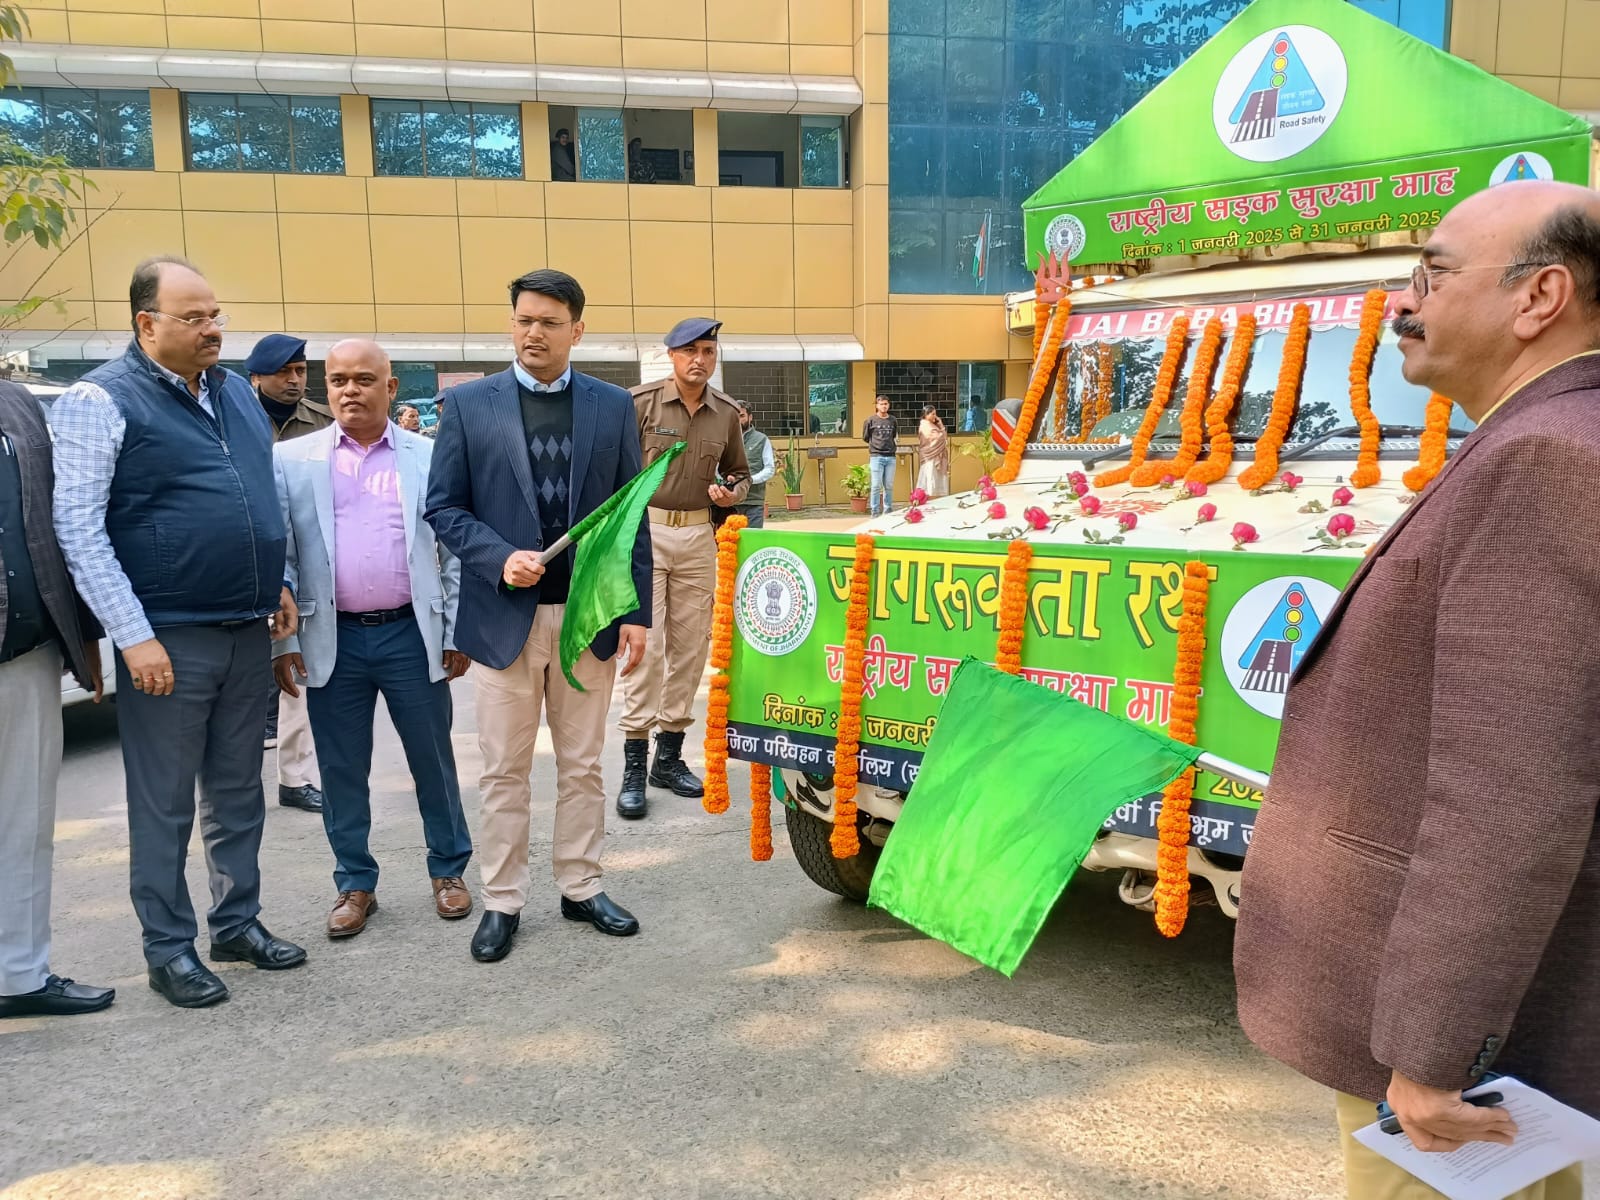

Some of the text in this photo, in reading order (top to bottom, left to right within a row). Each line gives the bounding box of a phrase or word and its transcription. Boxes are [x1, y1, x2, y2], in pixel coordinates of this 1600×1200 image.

[1279, 115, 1326, 129] Road Safety
[1107, 167, 1460, 236] राष्ट्रीय सड़क सुरक्षा माह
[1122, 241, 1164, 258] दिनांक
[1191, 231, 1240, 251] जनवरी
[1246, 228, 1283, 245] 2025
[1288, 224, 1304, 240] से
[1310, 222, 1329, 238] 31
[1336, 213, 1391, 235] जनवरी
[1398, 210, 1441, 229] 2025
[1071, 314, 1128, 337] JAI
[763, 693, 824, 727] दिनांक
[1125, 678, 1204, 727] मा
[725, 727, 760, 753] जिला
[763, 734, 822, 764] परिवहन
